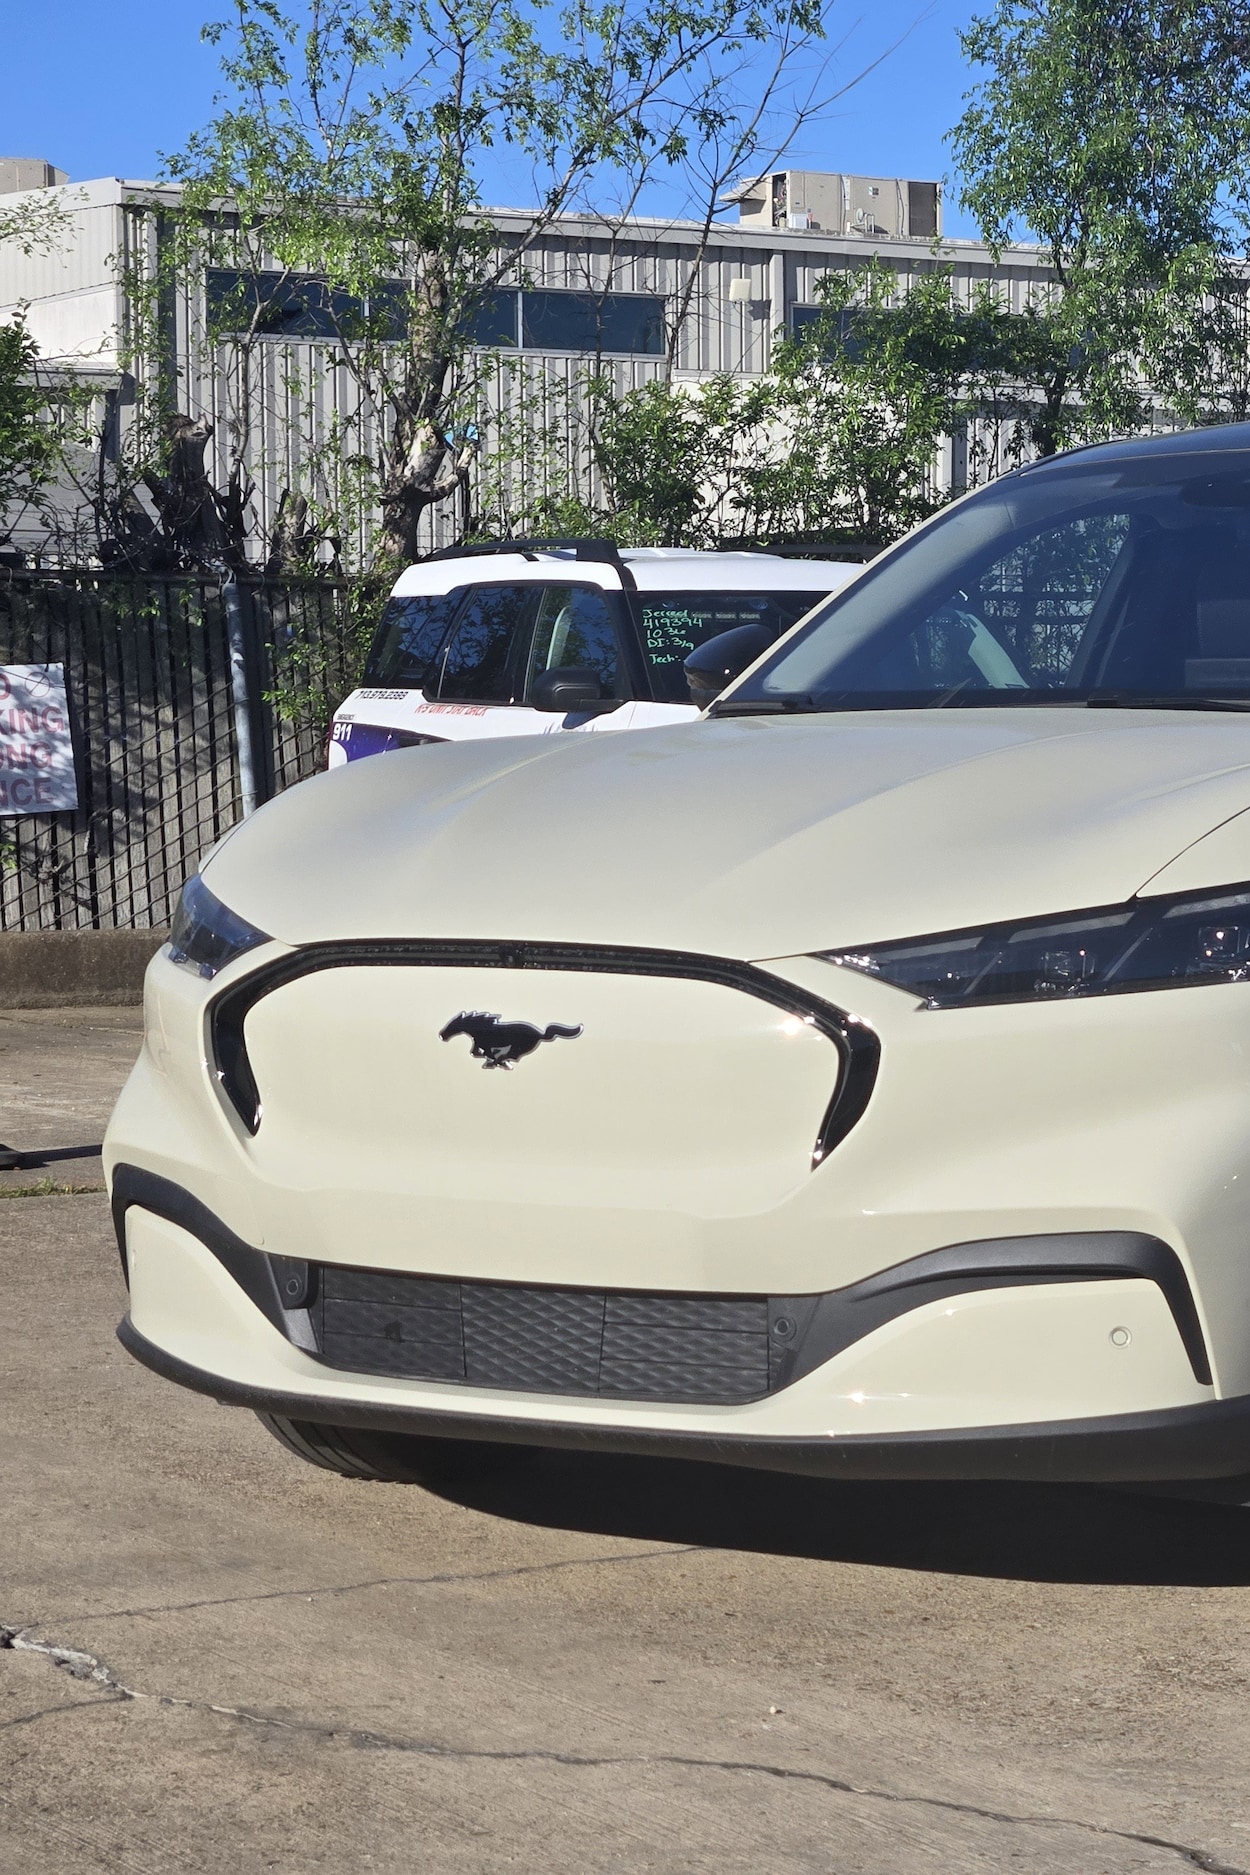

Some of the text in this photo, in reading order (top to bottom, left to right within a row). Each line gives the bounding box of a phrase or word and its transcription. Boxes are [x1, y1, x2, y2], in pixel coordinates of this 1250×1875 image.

[643, 617, 702, 629] 419394
[647, 629, 662, 638] 10
[0, 705, 64, 735] ING
[333, 723, 353, 741] 911
[0, 741, 52, 770] NG
